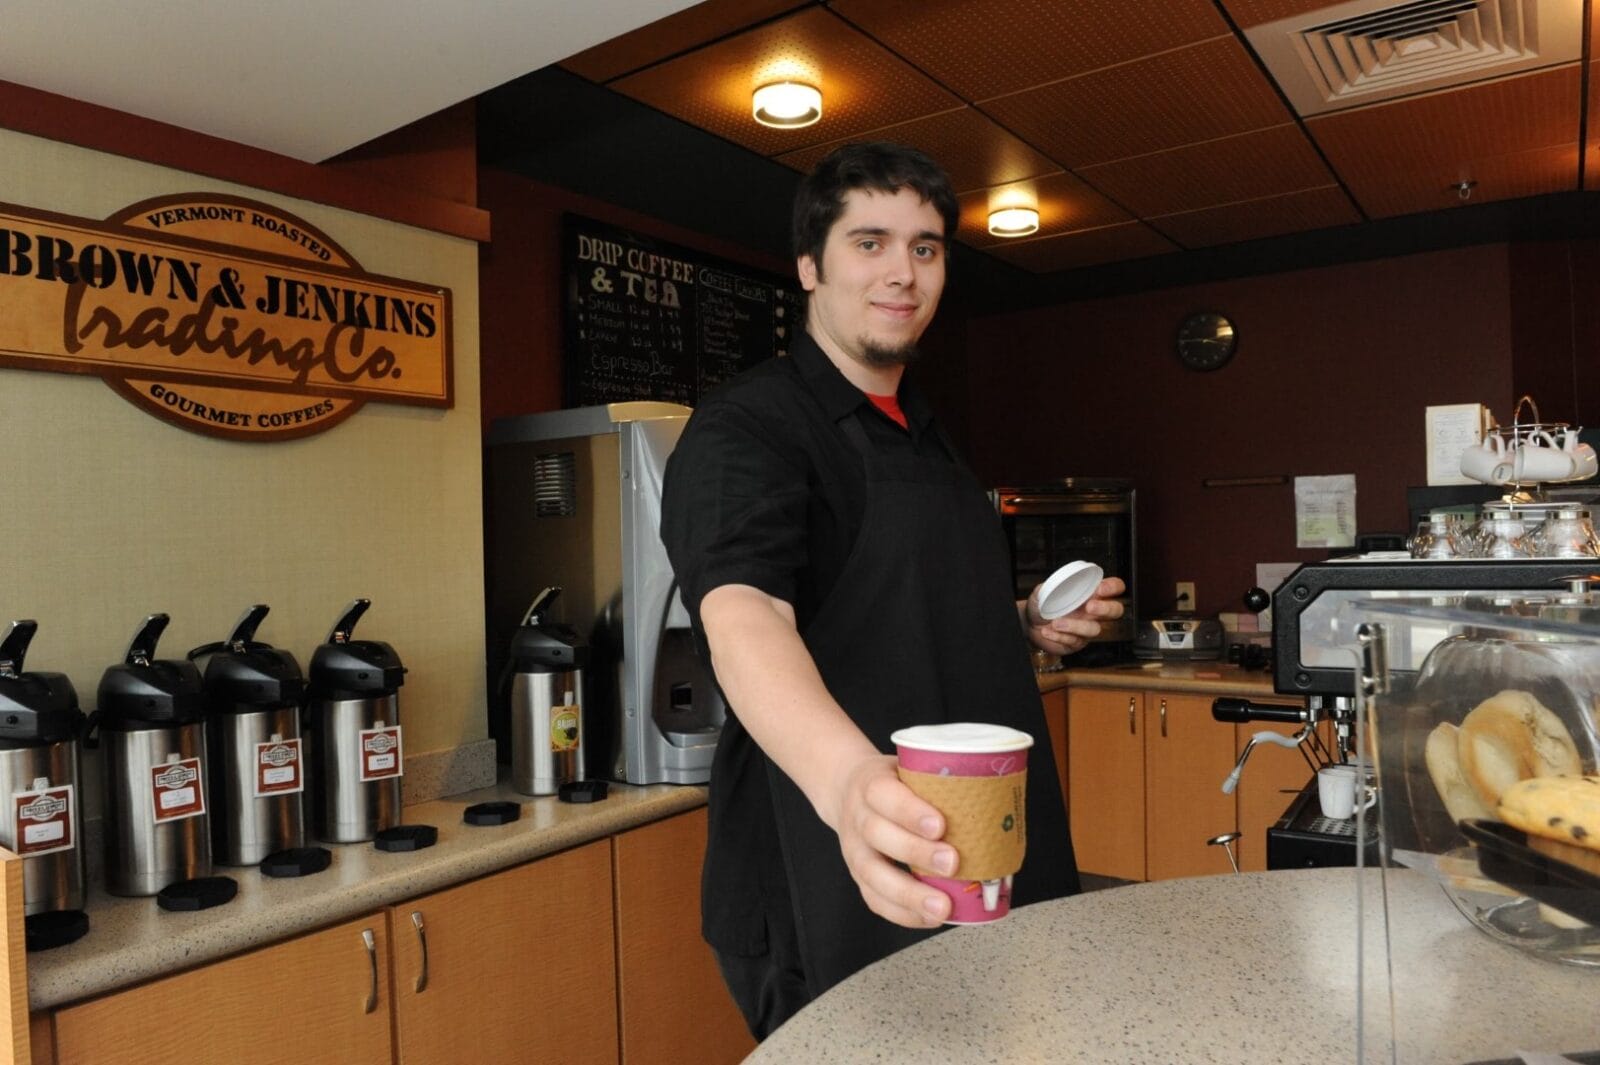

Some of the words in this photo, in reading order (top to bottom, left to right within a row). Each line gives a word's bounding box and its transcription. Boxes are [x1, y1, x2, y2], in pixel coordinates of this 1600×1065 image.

[146, 205, 246, 229] VERMONT
[251, 213, 333, 262] ROASTED
[0, 228, 202, 301] BROWN
[211, 267, 247, 311] &
[256, 274, 436, 339] JENKINS
[578, 235, 623, 267] DRIP
[627, 248, 694, 284] COFFEE
[591, 267, 614, 293] &
[620, 270, 681, 310] TEA
[54, 262, 315, 386] Trading
[322, 322, 403, 384] Co.
[591, 345, 650, 377] Espresso
[649, 350, 675, 377] Bar
[149, 384, 252, 427] GOURMET
[257, 399, 335, 428] COFFEES
